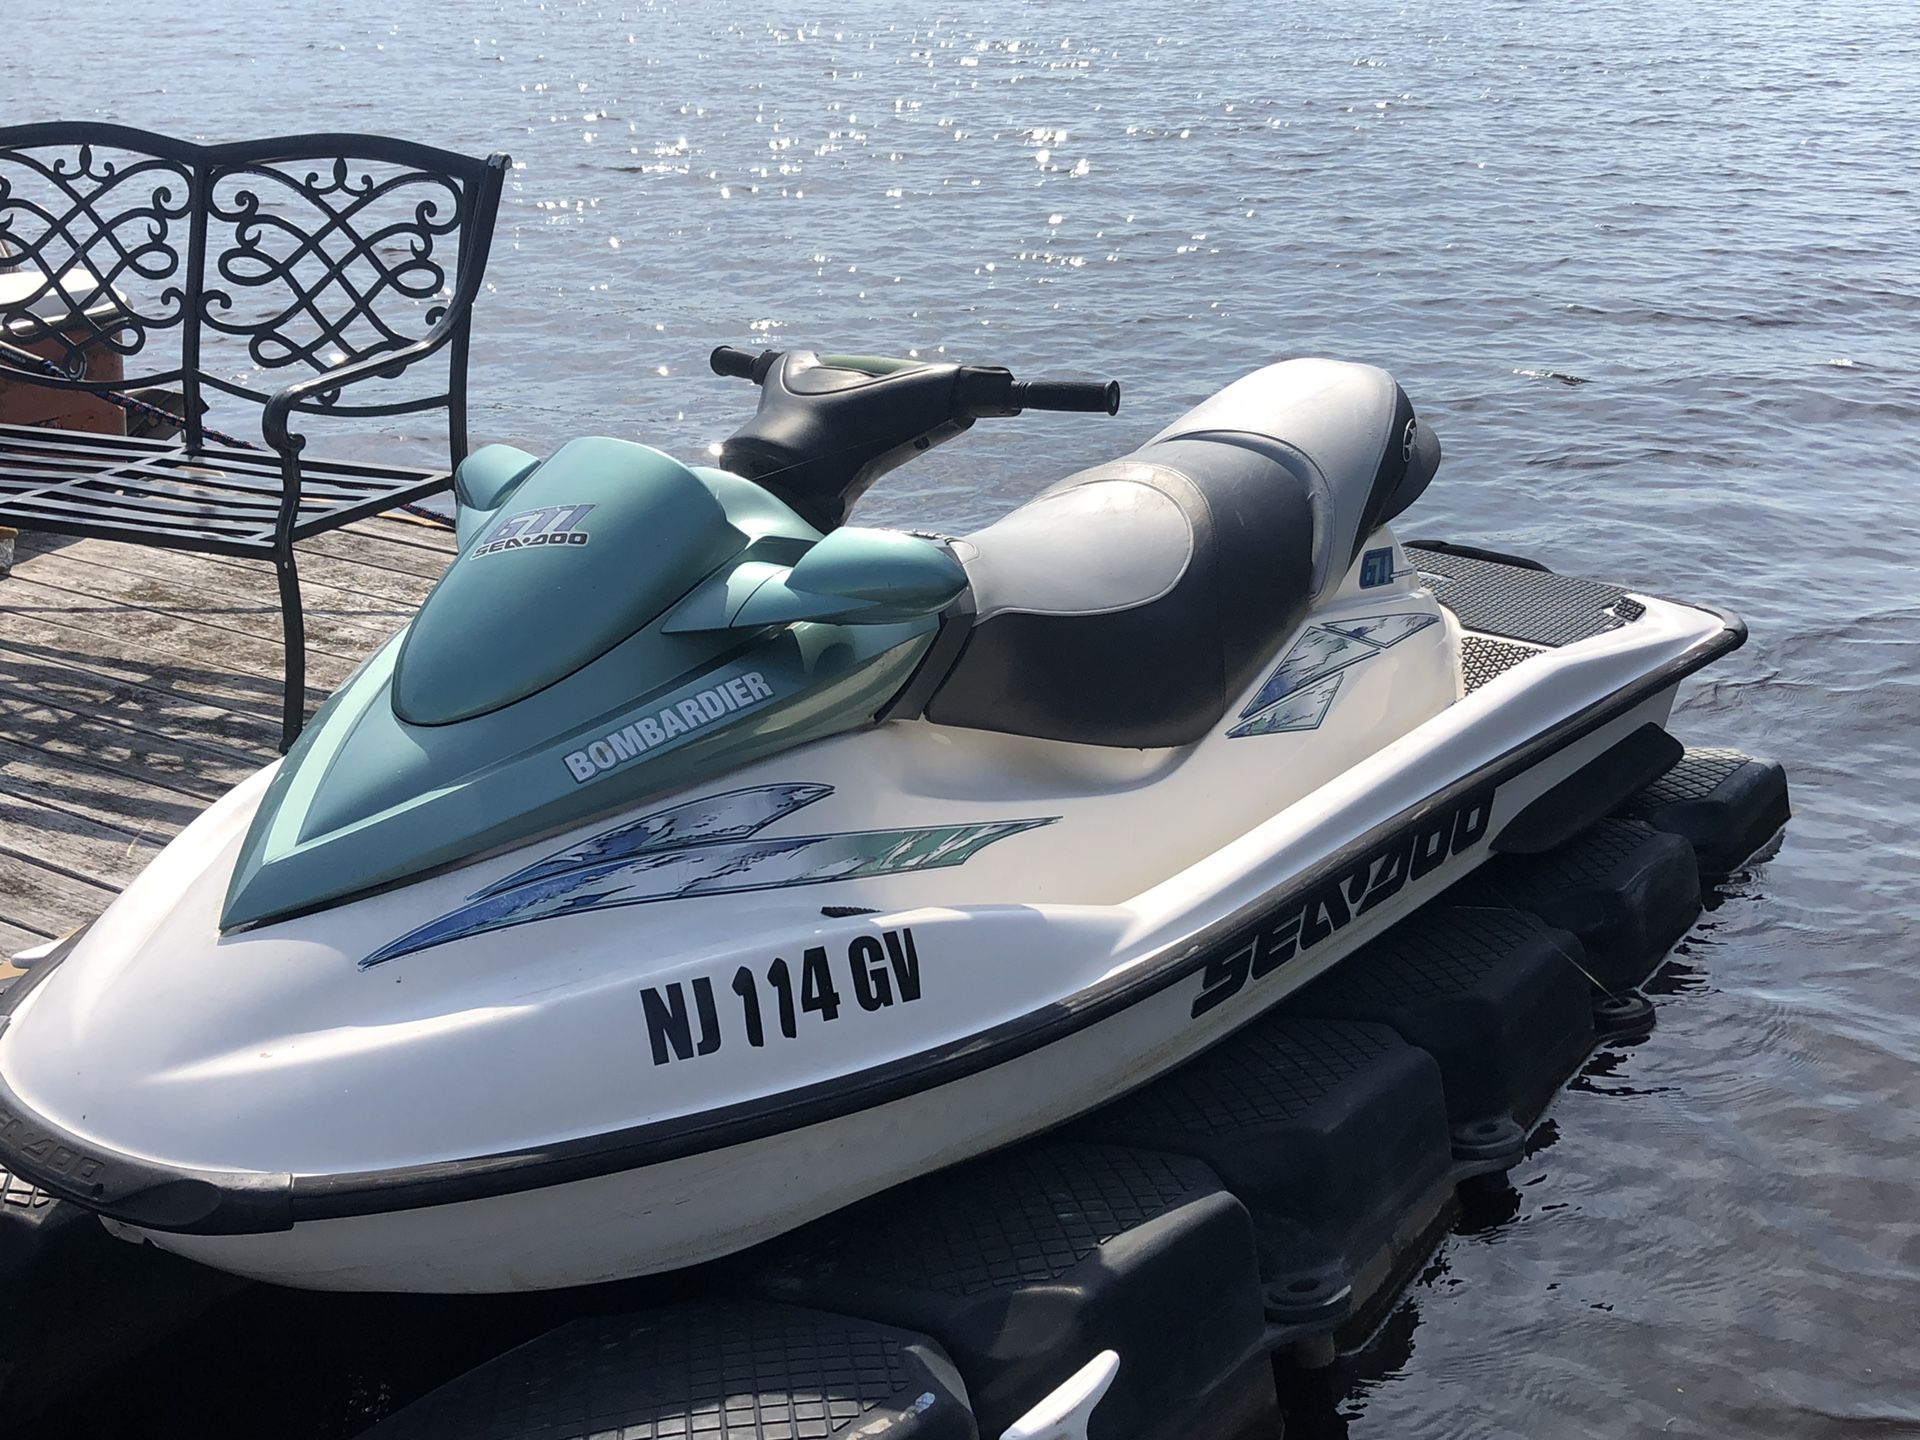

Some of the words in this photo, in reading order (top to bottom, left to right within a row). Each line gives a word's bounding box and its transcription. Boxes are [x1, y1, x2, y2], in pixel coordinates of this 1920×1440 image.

[563, 671, 774, 783] BOMBARDIER
[640, 976, 722, 1066] NJ
[732, 946, 841, 1047] 114
[848, 928, 921, 1012] GV
